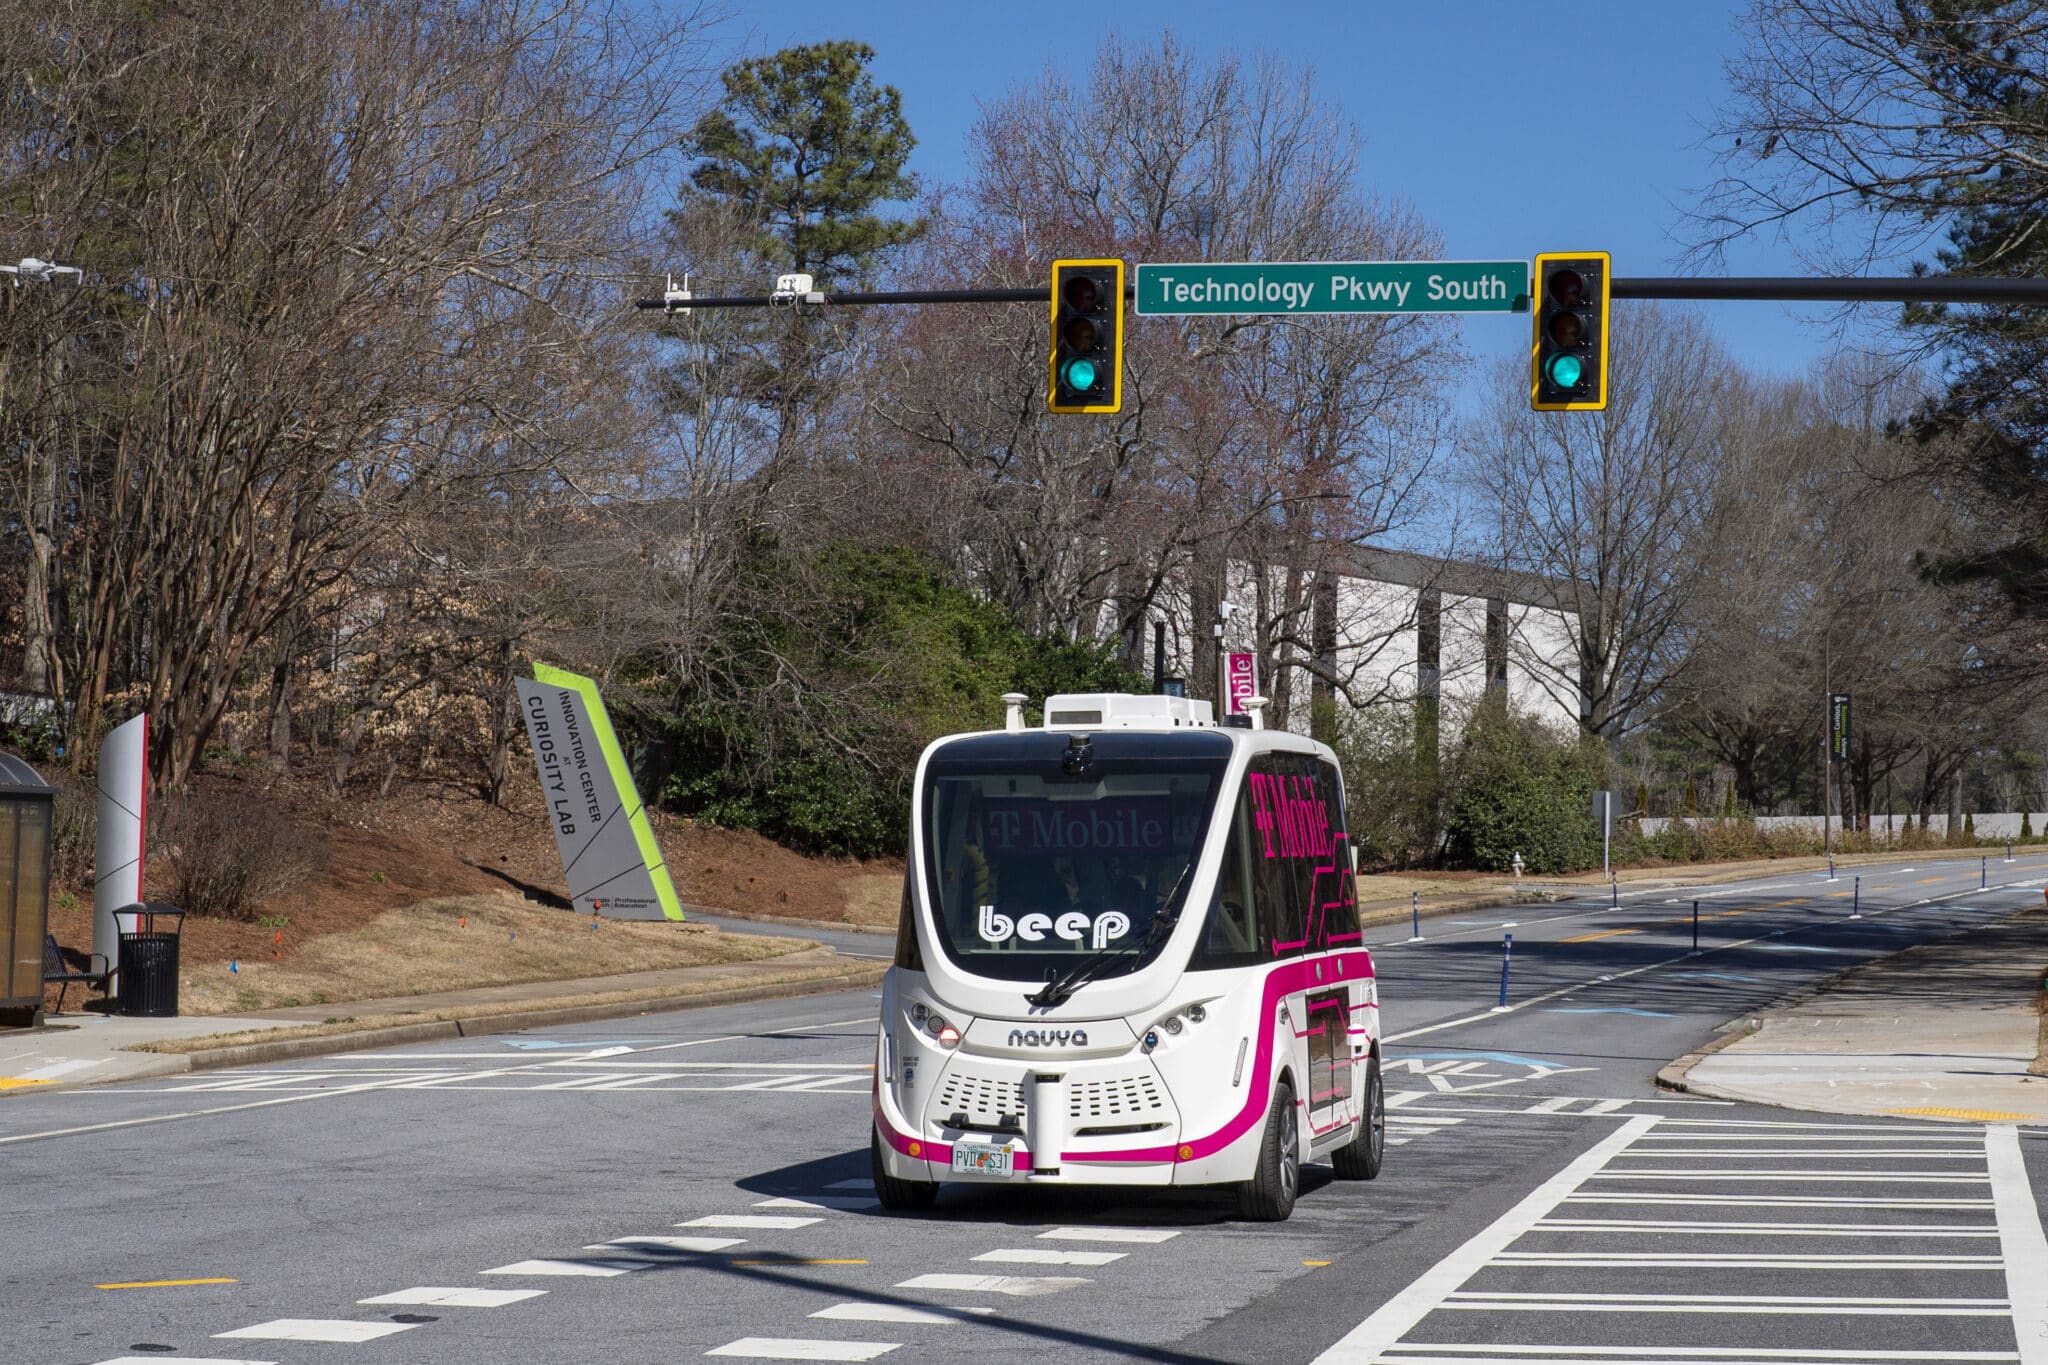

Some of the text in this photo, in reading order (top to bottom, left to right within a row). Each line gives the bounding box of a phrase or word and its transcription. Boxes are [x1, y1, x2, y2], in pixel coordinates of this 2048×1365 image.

[1158, 274, 1507, 310] Technology Pkwy South
[528, 696, 576, 836] CURIOSITY LAB
[558, 691, 601, 823] INNOVATION CENTER
[563, 756, 571, 767] AT
[1030, 809, 1164, 849] Mobile
[1267, 775, 1331, 858] Mobile
[978, 905, 1130, 949] beep
